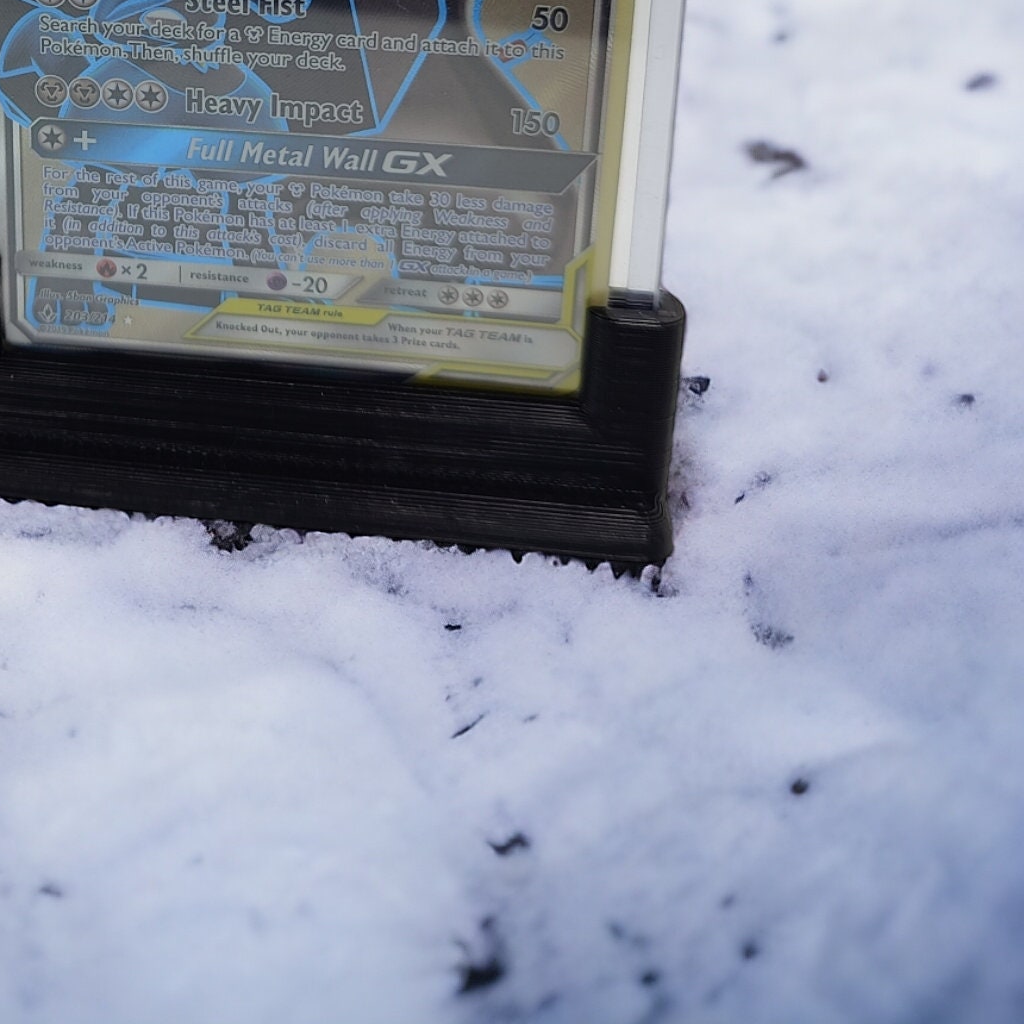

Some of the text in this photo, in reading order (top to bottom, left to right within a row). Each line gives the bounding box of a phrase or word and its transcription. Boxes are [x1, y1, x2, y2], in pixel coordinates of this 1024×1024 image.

[39, 14, 565, 60] Search your deck for a Energy card and attach it to this
[531, 5, 569, 32] 50
[41, 37, 346, 71] Pokémon. Then, shuffle your deck.
[185, 87, 560, 136] Heavy Impact 150
[187, 136, 454, 177] Full Metal Wall GX
[42, 165, 555, 217] For the rest of this game, your Pokémon take 30 less damage
[42, 182, 555, 233] from your opponent's attacks (after applying Weakness and
[44, 199, 551, 251] Resistance). If this Pokémon has at least extra Energy attached to
[44, 215, 551, 269] it (in addition to this attack's discard all Energy from your
[44, 234, 124, 251] opponent's
[125, 236, 174, 254] Active
[176, 240, 249, 260] Pokémon.
[250, 249, 276, 265] (You
[307, 254, 326, 265] use
[328, 256, 357, 267] more
[360, 257, 385, 270] than
[399, 261, 430, 274] GX
[29, 257, 83, 271] weakness
[190, 269, 249, 284] resistance
[384, 285, 427, 298] retreat
[257, 303, 282, 314] TAG
[285, 304, 321, 317] TEAM
[285, 328, 308, 339] your
[388, 322, 417, 335] When
[419, 326, 443, 337] your
[445, 326, 476, 339] TAG
[479, 329, 521, 344] TEAM
